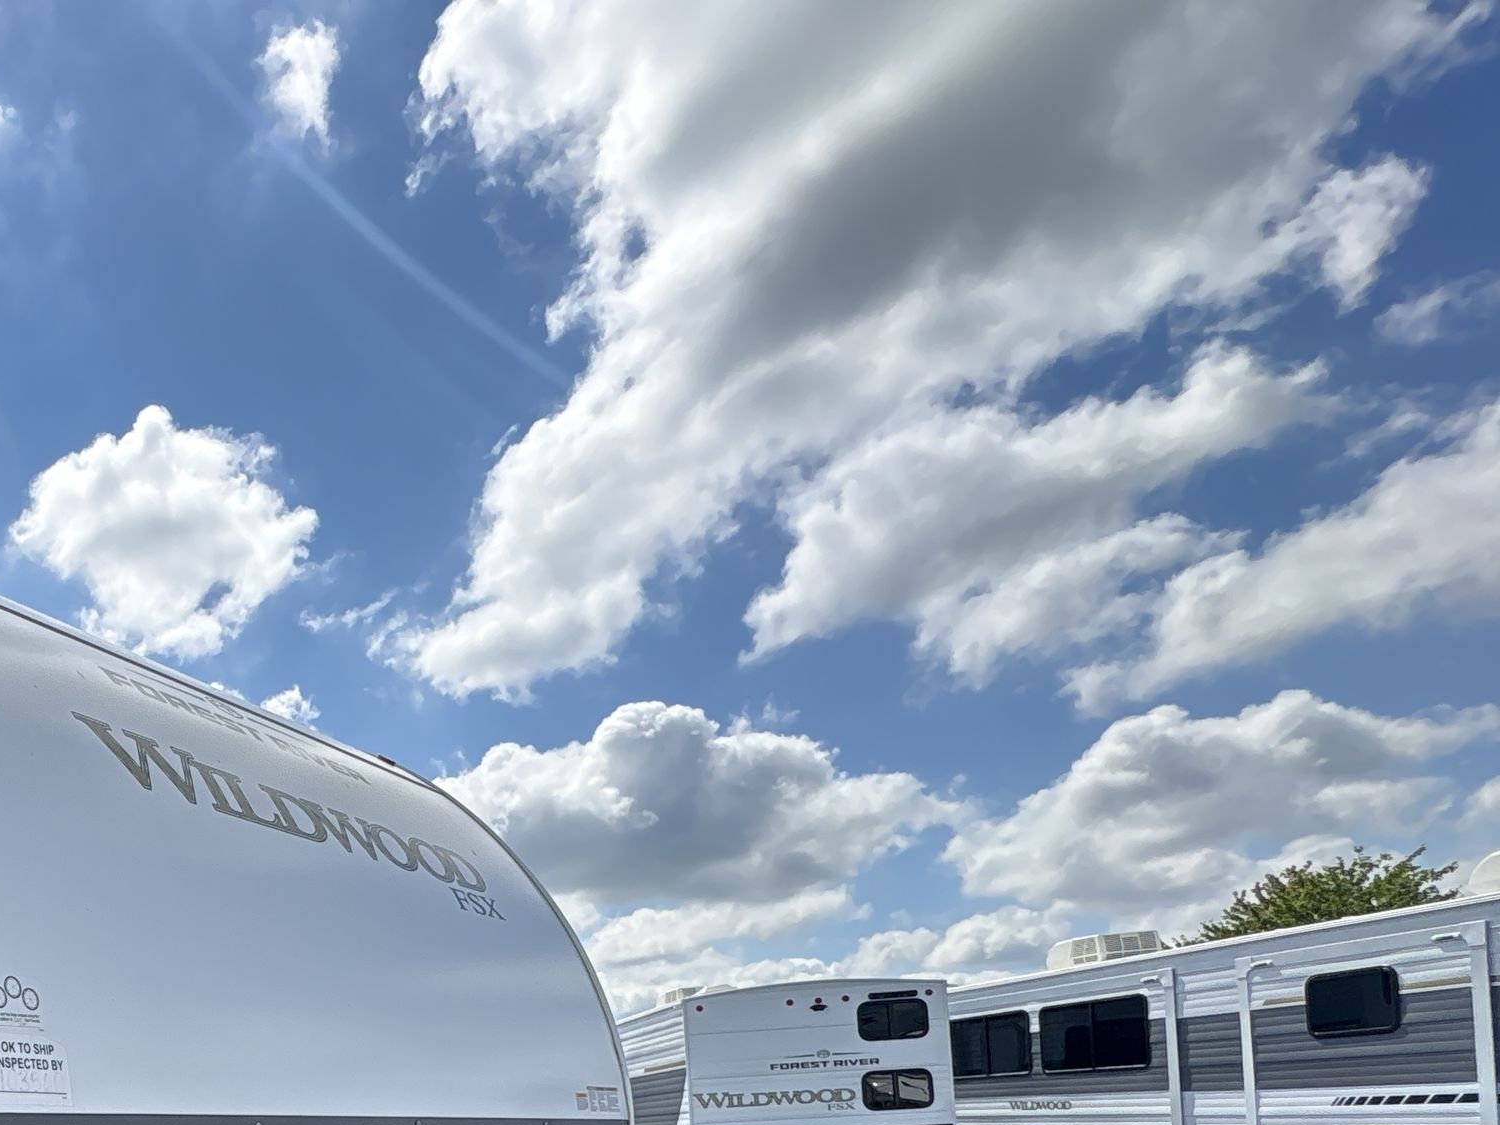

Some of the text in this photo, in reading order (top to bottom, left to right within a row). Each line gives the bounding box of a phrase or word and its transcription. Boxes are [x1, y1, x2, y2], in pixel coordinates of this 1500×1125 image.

[98, 665, 371, 785] FOREST RIVER
[71, 711, 487, 893] WILDWOOD
[450, 886, 507, 921] FSX
[1, 1041, 54, 1055] OK TO SHIP
[50, 1060, 63, 1071] BY
[770, 1057, 880, 1071] FOREST RIVER
[693, 1088, 856, 1109] WILDWOOD
[1008, 1100, 1072, 1110] WILDWOOD
[827, 1103, 856, 1111] FSX
